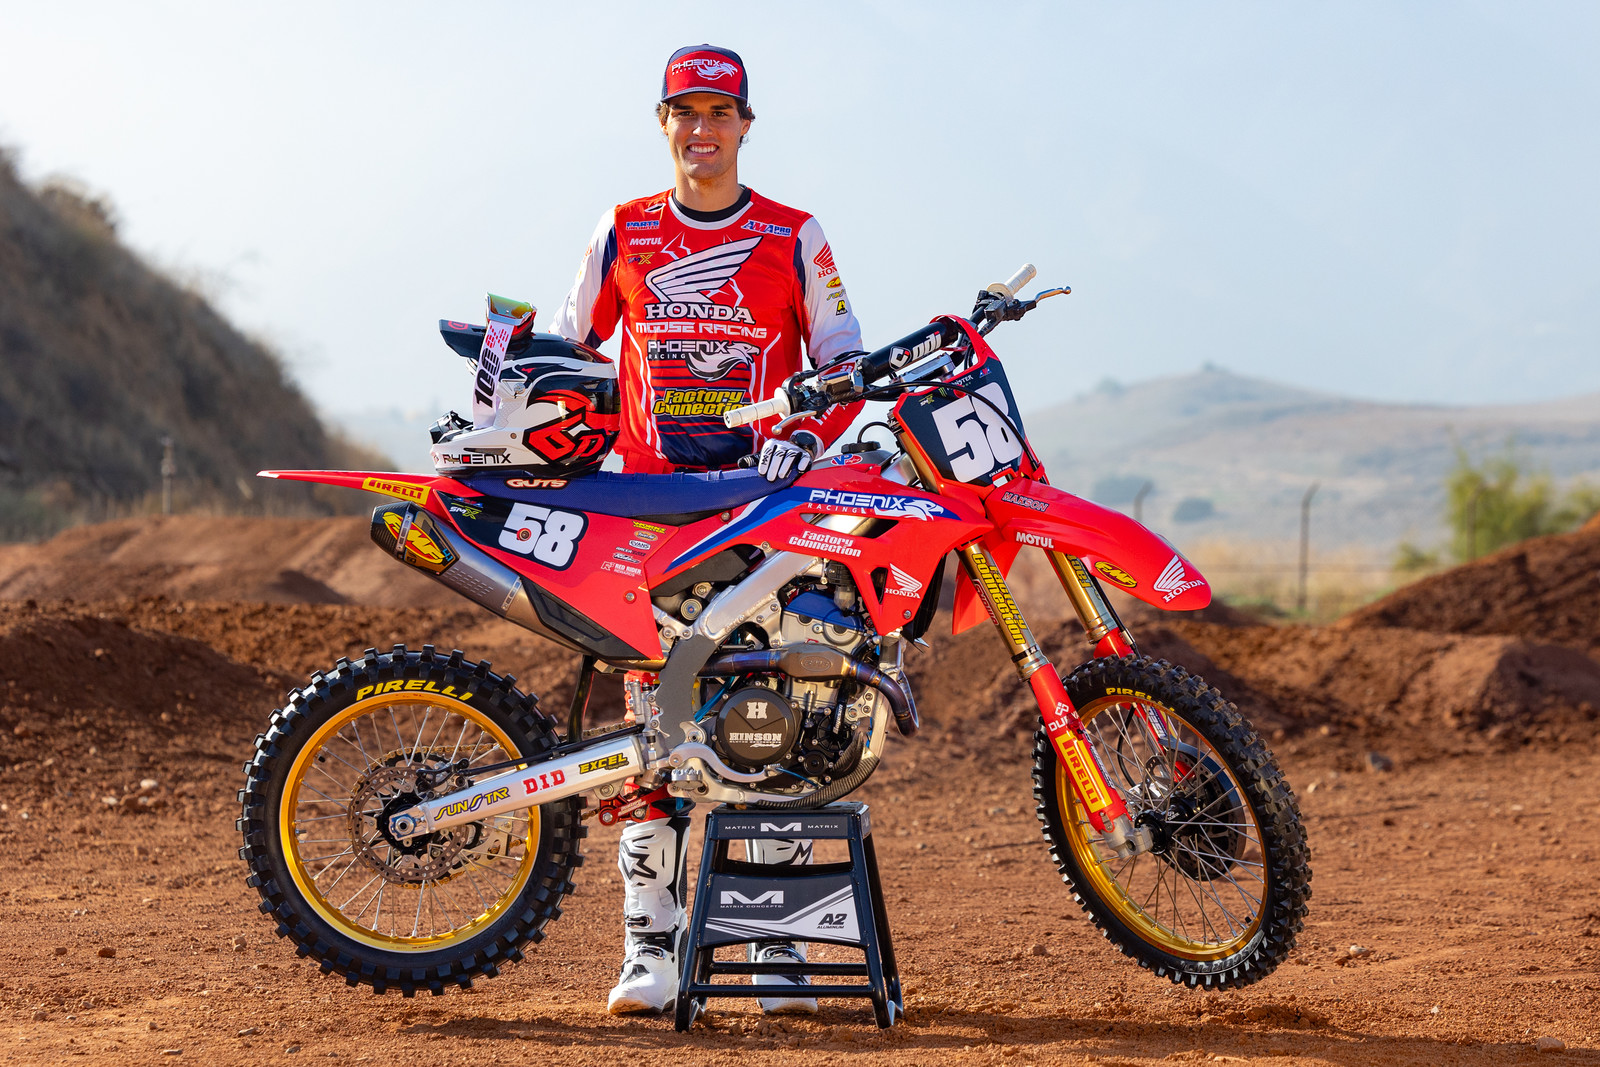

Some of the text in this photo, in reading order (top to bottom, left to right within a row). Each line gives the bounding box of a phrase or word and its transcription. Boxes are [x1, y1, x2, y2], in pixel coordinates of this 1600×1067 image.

[671, 59, 720, 71] PHOENIX
[742, 221, 791, 233] AMA PRO
[630, 237, 662, 246] MOTUL
[645, 303, 756, 325] HONDA
[635, 321, 767, 338] MOOSE RACING
[648, 341, 729, 353] PHOENIX
[664, 389, 743, 404] Factory
[931, 381, 1023, 483] 58
[442, 454, 512, 464] PHOENIX
[833, 453, 854, 465] VP
[368, 479, 424, 499] PIRELLI
[506, 479, 568, 488] GUTS
[809, 490, 906, 509] PHOENIX
[449, 505, 480, 520] SMX
[807, 503, 858, 514] RACING
[498, 502, 585, 567] 58
[802, 530, 854, 546] Factory
[1016, 531, 1054, 548] MOTUL
[789, 536, 862, 557] Connection
[615, 563, 642, 574] RED RIDER
[1095, 562, 1137, 588] FMF
[885, 588, 921, 599] HONDA
[972, 552, 1026, 645] Connection
[1163, 579, 1206, 602] HONDA
[356, 680, 474, 701] PIRELLI
[747, 702, 768, 719] H
[729, 732, 782, 741] HINSON
[580, 753, 628, 774] EXCEL
[1062, 737, 1104, 804] PIRELLI
[523, 769, 566, 795] D.I.D
[818, 913, 847, 925] A2
